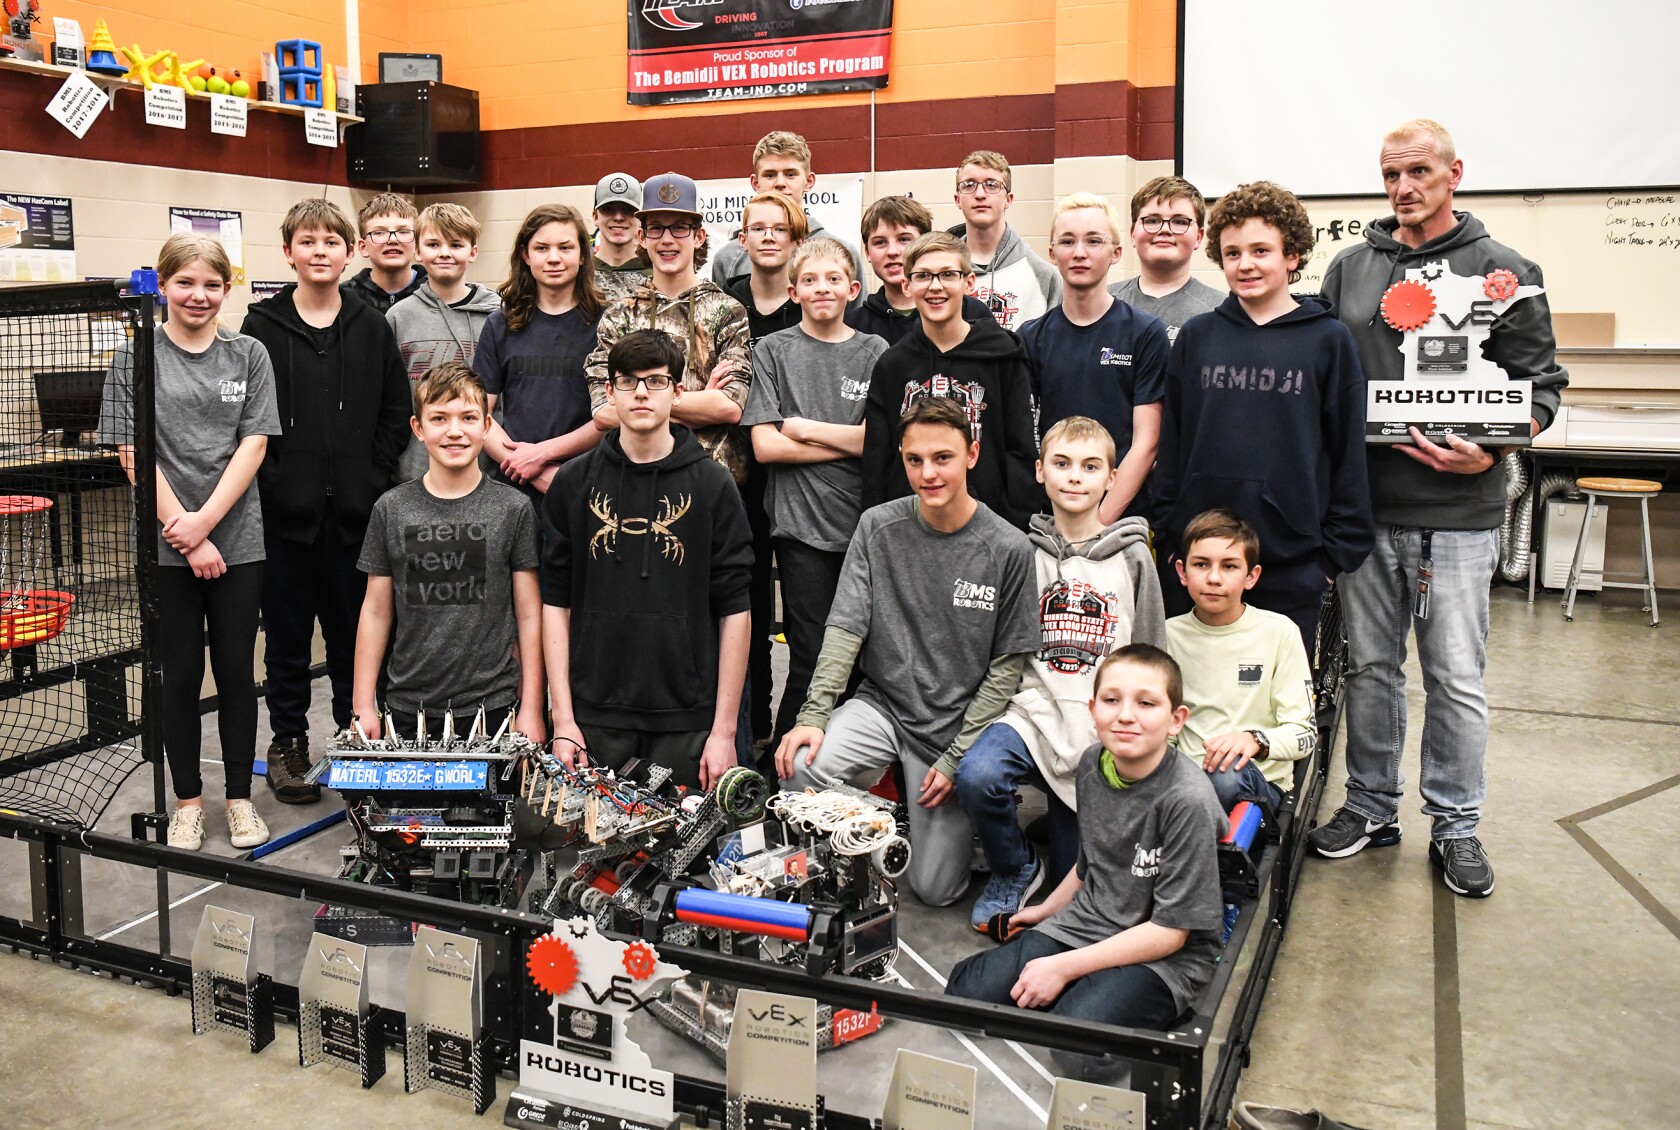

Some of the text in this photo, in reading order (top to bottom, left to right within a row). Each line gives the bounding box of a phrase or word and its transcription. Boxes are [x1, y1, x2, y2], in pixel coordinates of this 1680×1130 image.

[714, 13, 757, 24] DRIVING
[731, 20, 795, 33] INNOVATION
[713, 46, 797, 63] Proud Sponsor of
[634, 55, 884, 87] The Bemidji VEX Robotics Program
[60, 86, 73, 101] BMS
[707, 83, 807, 98] TEAM-IND.COM
[62, 86, 84, 113] Robotics
[65, 87, 94, 124] Competition
[153, 95, 178, 103] Robotics
[148, 102, 183, 112] Competition
[214, 112, 245, 121] Competition
[6, 195, 17, 203] The
[18, 196, 31, 204] NEW
[1606, 197, 1631, 209] CHAIR
[1605, 231, 1626, 245] NIGHT
[1439, 300, 1520, 330] VEX
[1375, 390, 1524, 404] ROBOTICS
[417, 524, 486, 541] aero
[953, 578, 996, 601] BMS
[953, 598, 995, 611] ROBOTICS
[1043, 613, 1105, 626] MINNESOTA STATE
[1044, 621, 1103, 635] VEX ROBOTICS
[331, 768, 475, 784] MATERL 1532E GWORL
[213, 935, 247, 948] ROBOTIC
[213, 941, 248, 955] COMPETITIO
[320, 963, 361, 979] ROBOTIC
[582, 975, 660, 1017] VEX
[332, 1016, 352, 1028] VEX
[747, 1004, 808, 1028] VEX
[746, 1024, 810, 1038] ROBOTICS
[747, 1032, 810, 1046] COMPETITION
[440, 1040, 462, 1053] VEX
[527, 1052, 666, 1097] ROBOTICS
[905, 1085, 970, 1108] ROBOTICS
[905, 1094, 969, 1115] COMPETITION
[528, 1111, 546, 1120] GREDE
[571, 1110, 606, 1123] COLDSPRING
